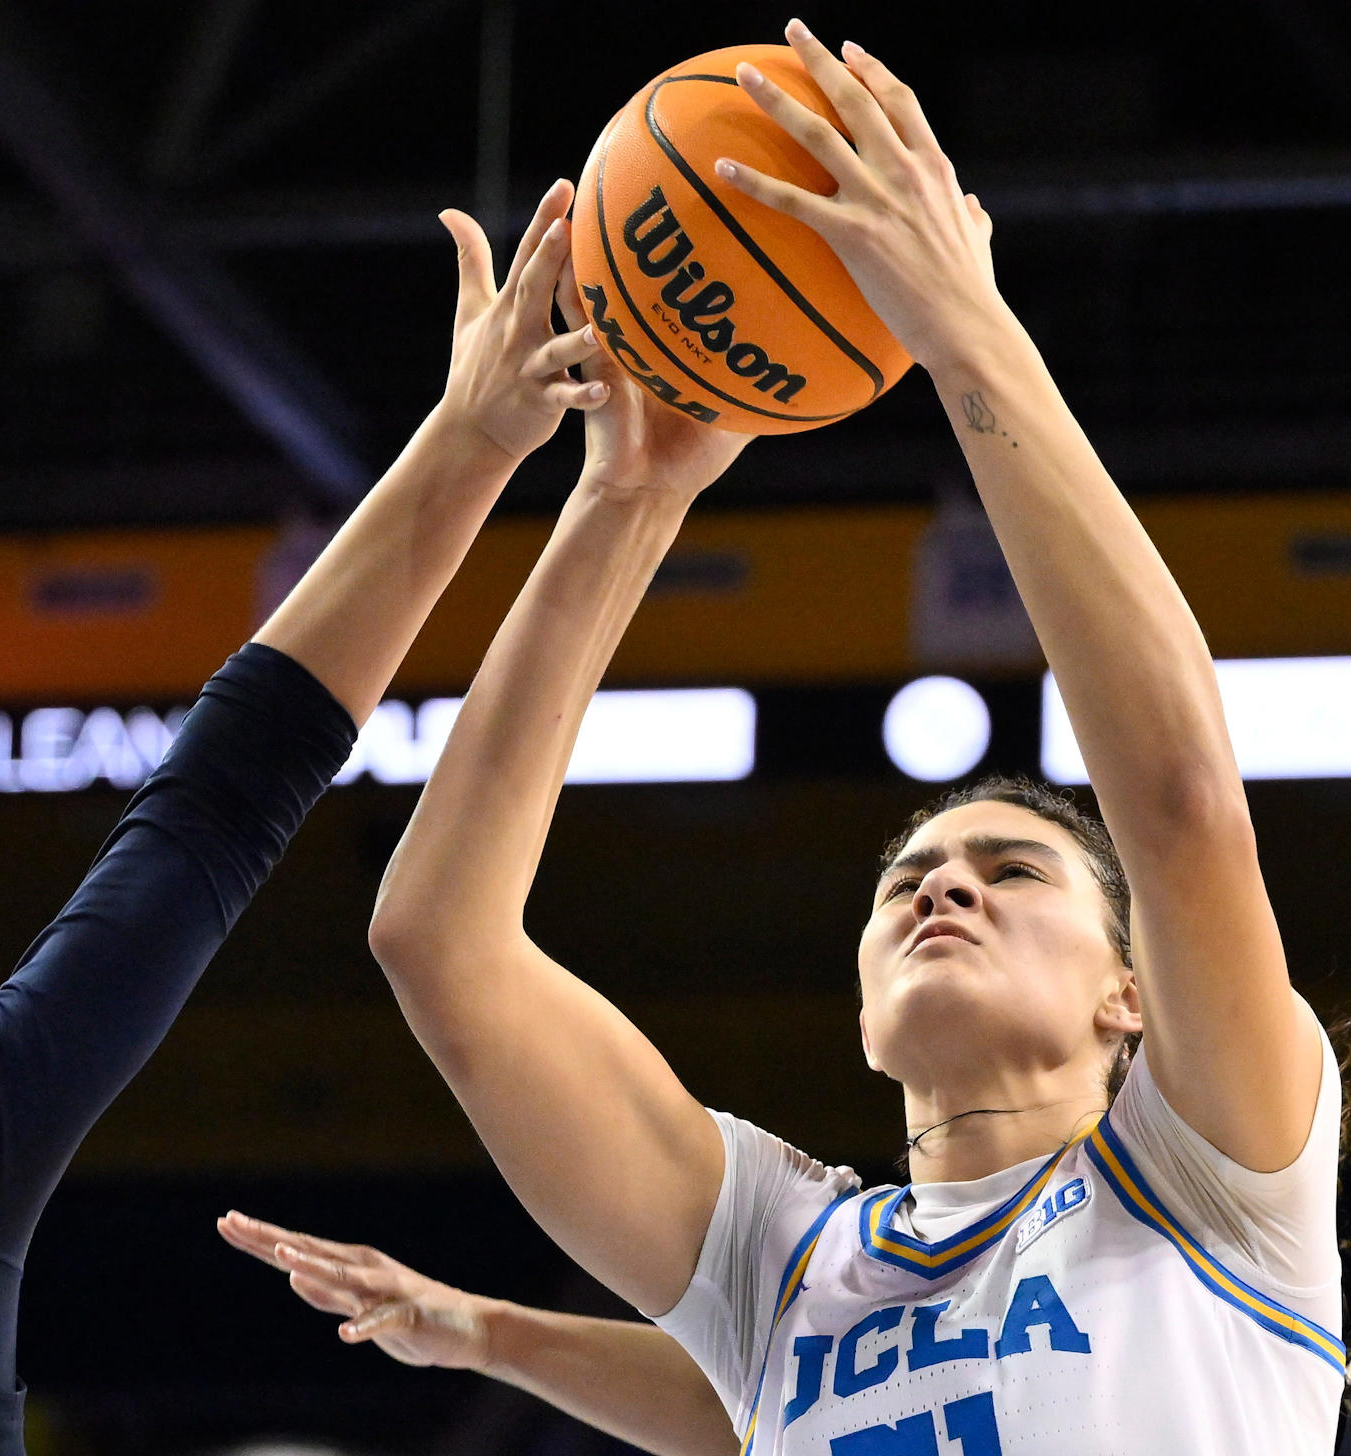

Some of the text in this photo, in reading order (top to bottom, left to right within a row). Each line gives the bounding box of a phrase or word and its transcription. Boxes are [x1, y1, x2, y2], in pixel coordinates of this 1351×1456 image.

[581, 284, 721, 425] NCAA
[623, 184, 807, 405] Wilson
[651, 302, 713, 365] EVO NXT
